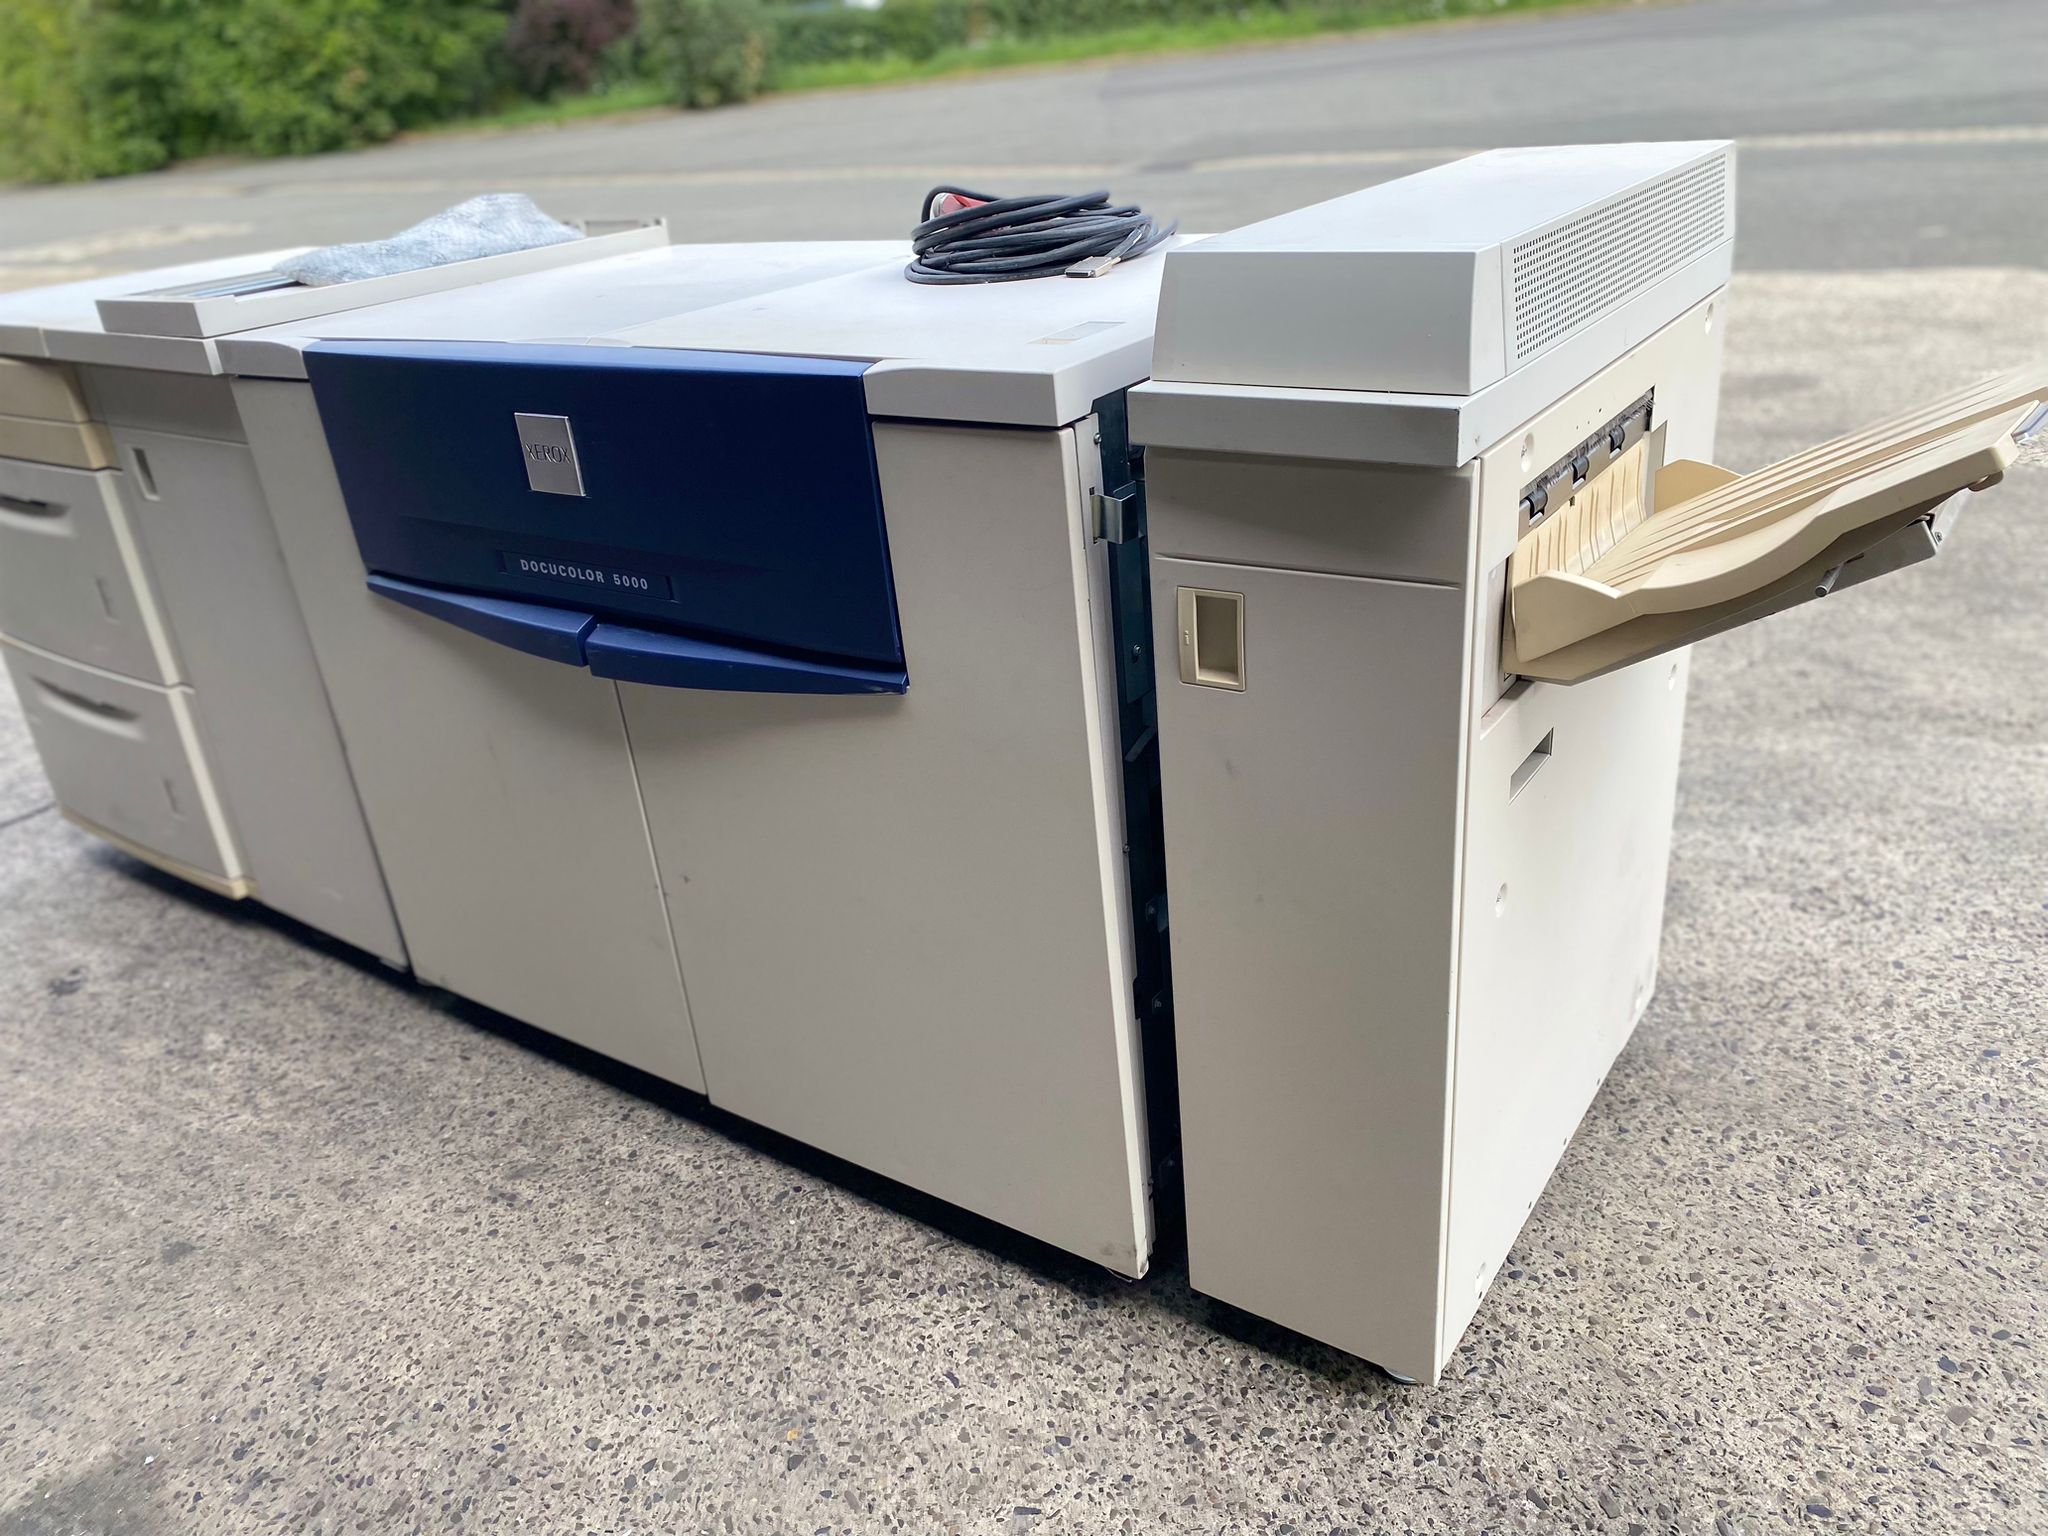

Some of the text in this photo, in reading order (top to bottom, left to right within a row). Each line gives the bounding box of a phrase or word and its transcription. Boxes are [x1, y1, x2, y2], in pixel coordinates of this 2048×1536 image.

[526, 443, 571, 464] XEROX
[520, 559, 648, 590] DOCUCOLOR 5000
